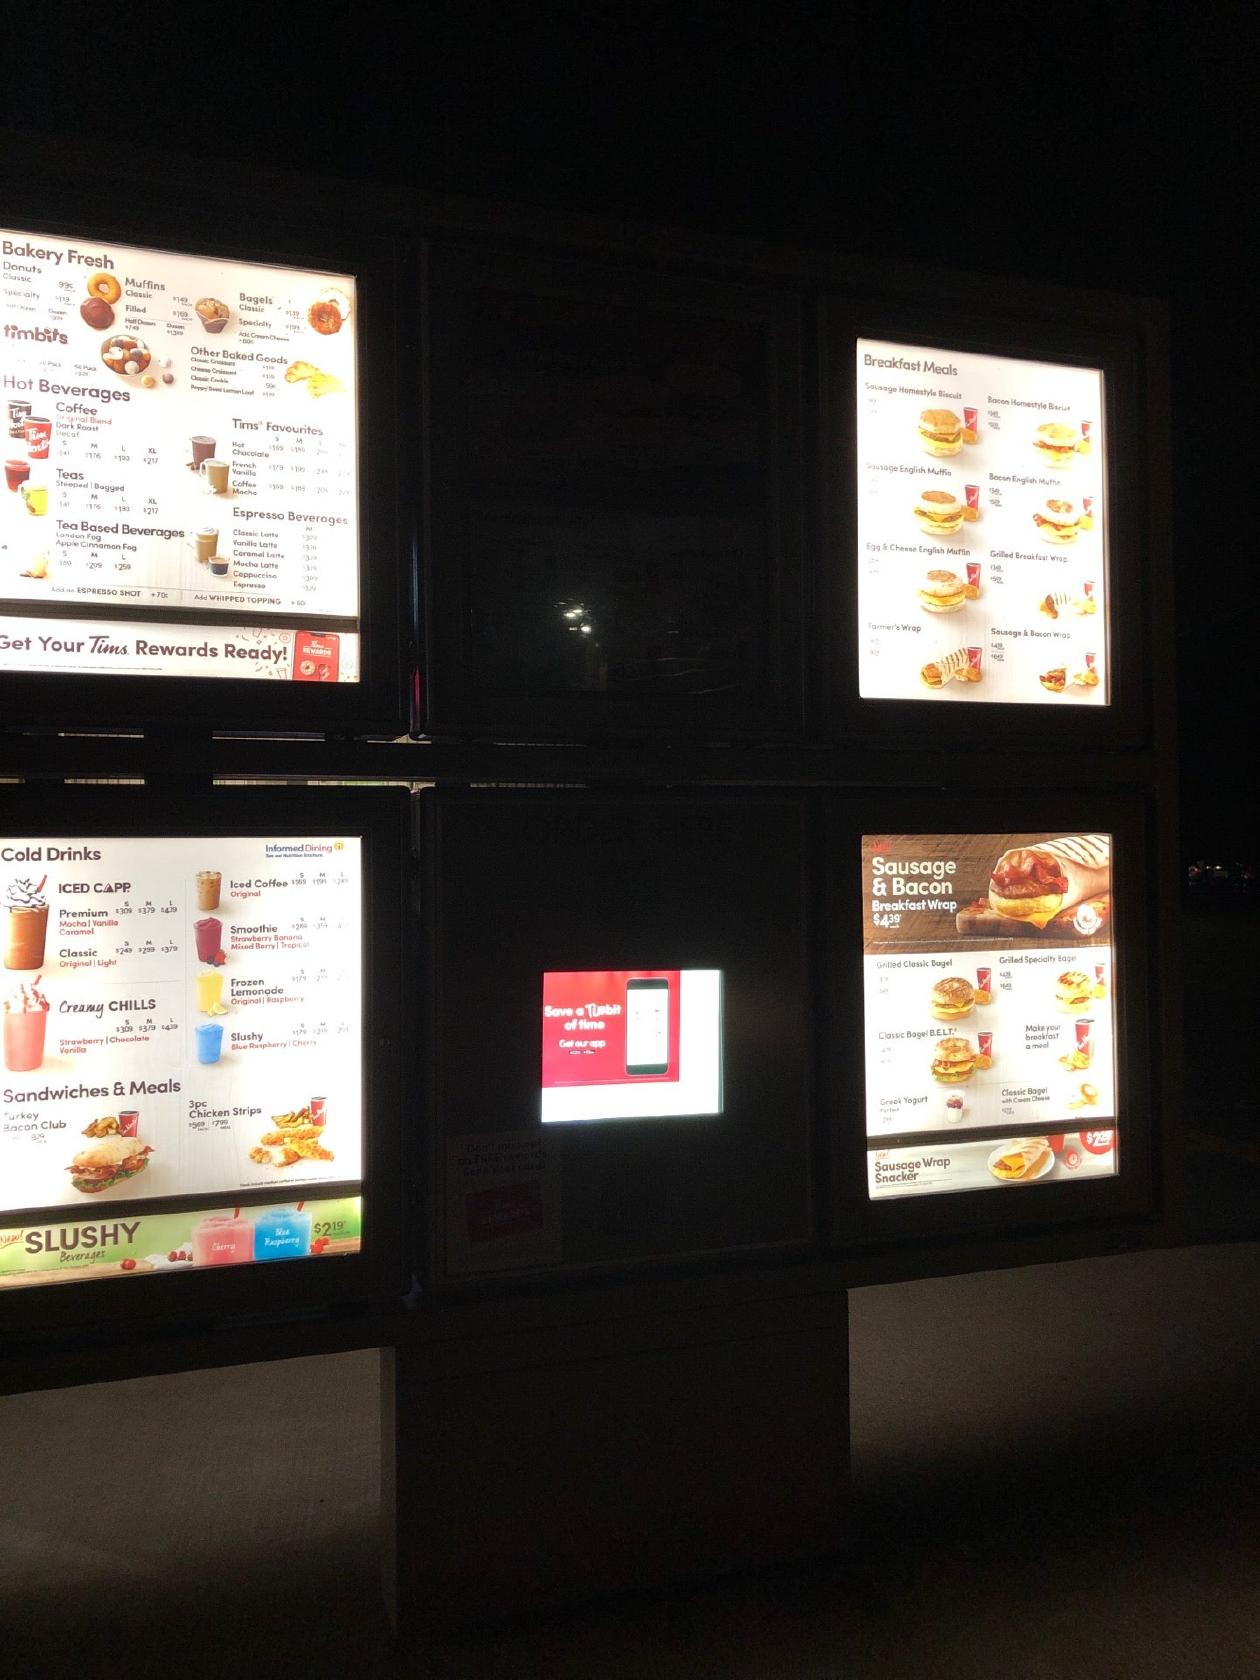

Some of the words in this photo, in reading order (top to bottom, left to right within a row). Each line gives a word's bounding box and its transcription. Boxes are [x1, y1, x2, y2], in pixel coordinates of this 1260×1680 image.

[3, 241, 63, 265] Bakery
[68, 250, 114, 269] Fresh
[3, 262, 42, 274] Donuts
[3, 273, 31, 283] Classic
[125, 278, 165, 291] Muffins
[125, 290, 152, 299] Classic
[240, 293, 272, 305] Bagels
[126, 305, 146, 314] Filled
[239, 304, 264, 312] Classic
[239, 318, 272, 328] Specialty
[4, 325, 68, 344] timbits
[191, 347, 220, 358] Other
[222, 350, 254, 361] Baked
[256, 354, 288, 365] Goods
[864, 354, 921, 371] Breakfast
[924, 361, 958, 376] Meals
[3, 376, 33, 390] Hot
[39, 379, 130, 403] Beverages
[865, 382, 897, 393] Sausage
[899, 386, 937, 397] Homestyle
[938, 390, 962, 399] Biscuit
[988, 396, 1010, 405] Bacon
[1011, 398, 1047, 410] Homestyle
[56, 402, 98, 415] Coffee
[266, 422, 323, 436] Favourites
[232, 449, 269, 458] Chocolate
[56, 468, 84, 480] Teas
[900, 465, 926, 475] English
[927, 468, 952, 476] Muffin
[232, 480, 257, 488] Coffee
[989, 473, 1011, 481] Bacon
[1012, 476, 1037, 485] English
[56, 480, 88, 489] Steeped
[94, 483, 125, 492] Bagged
[232, 488, 257, 496] Mocha
[233, 507, 285, 520] Espresso
[288, 512, 348, 526] Beverages
[56, 520, 78, 531] Tea
[81, 522, 119, 534] Based
[122, 524, 185, 540] Beverages
[56, 532, 85, 540] London
[87, 533, 101, 542] Fog
[56, 539, 79, 547] Apple
[81, 542, 121, 550] Cinnamon
[122, 544, 137, 552] Fog
[866, 543, 881, 551] Egg
[890, 544, 917, 553] Cheese
[919, 546, 944, 556] English
[947, 548, 971, 556] Muffin
[990, 550, 1014, 559] Grilled
[1015, 552, 1048, 561] Breakfast
[233, 571, 277, 580] Cappuccino
[233, 581, 266, 589] Espresso
[77, 587, 118, 596] ESPRESSO
[119, 589, 142, 597] SHOT
[209, 595, 245, 603] WHIPPED
[902, 624, 921, 633] Wrap
[991, 628, 1022, 638] Sausage
[1030, 630, 1051, 638] Bacon
[0, 635, 31, 651] Get
[38, 636, 84, 653] Your
[88, 635, 128, 655] Tims
[135, 640, 219, 658] Rewards
[224, 643, 288, 661] Ready!
[266, 844, 304, 853] Informed
[305, 844, 332, 853] Dining
[1, 847, 42, 862] Cold
[47, 847, 101, 861] Drinks
[872, 857, 956, 880] Sausage
[59, 883, 90, 893] ICED
[230, 880, 252, 888] Iced
[254, 879, 288, 888] Coffee
[872, 878, 887, 896] &
[892, 878, 953, 896] Bacon
[230, 891, 261, 899] Original
[872, 900, 926, 912] Breakfast
[928, 900, 957, 913] Wrap
[59, 909, 108, 918] Premium
[59, 920, 87, 928] Mocha
[230, 925, 278, 934] Smoothie
[255, 942, 275, 950] Berry
[59, 949, 98, 958] Classic
[59, 960, 92, 968] Original
[98, 959, 117, 967] Light
[877, 961, 901, 969] Grilled
[903, 959, 929, 968] Classic
[931, 959, 953, 968] Bagel
[999, 956, 1023, 964] Grilled
[1025, 955, 1056, 964] Specialty
[231, 979, 264, 987] Frozen
[231, 987, 284, 996] Lemonade
[231, 997, 261, 1005] Original
[59, 1000, 104, 1019] Creamy
[109, 999, 156, 1011] CHILLS
[544, 1005, 573, 1017] Save
[576, 1008, 584, 1016] a
[564, 1020, 576, 1031] of
[579, 1020, 605, 1030] time
[231, 1032, 263, 1042] Slushy
[879, 1031, 905, 1040] Classic
[907, 1029, 929, 1039] Bagel
[1026, 1032, 1059, 1041] breakfast
[60, 1038, 104, 1046] Strawberry
[559, 1040, 573, 1048] Get
[60, 1046, 86, 1054] Vanilla
[3, 1085, 109, 1103] Sandwiches
[113, 1082, 125, 1096] &
[129, 1078, 181, 1096] Meals
[1002, 1087, 1026, 1096] Classic
[1027, 1087, 1048, 1096] Bagel
[189, 1100, 207, 1109] 3pc
[189, 1108, 230, 1119] Chicken
[233, 1106, 262, 1118] Strips
[3, 1123, 39, 1133] Bacon
[41, 1121, 67, 1130] Club
[875, 1159, 921, 1173] Sausage
[922, 1157, 951, 1168] Wrap
[875, 1172, 919, 1184] Snacker
[25, 1222, 141, 1254] SLUSHY
[264, 1237, 300, 1247] Raspberry
[212, 1242, 236, 1254] Cherry
[60, 1250, 105, 1263] Beverages
